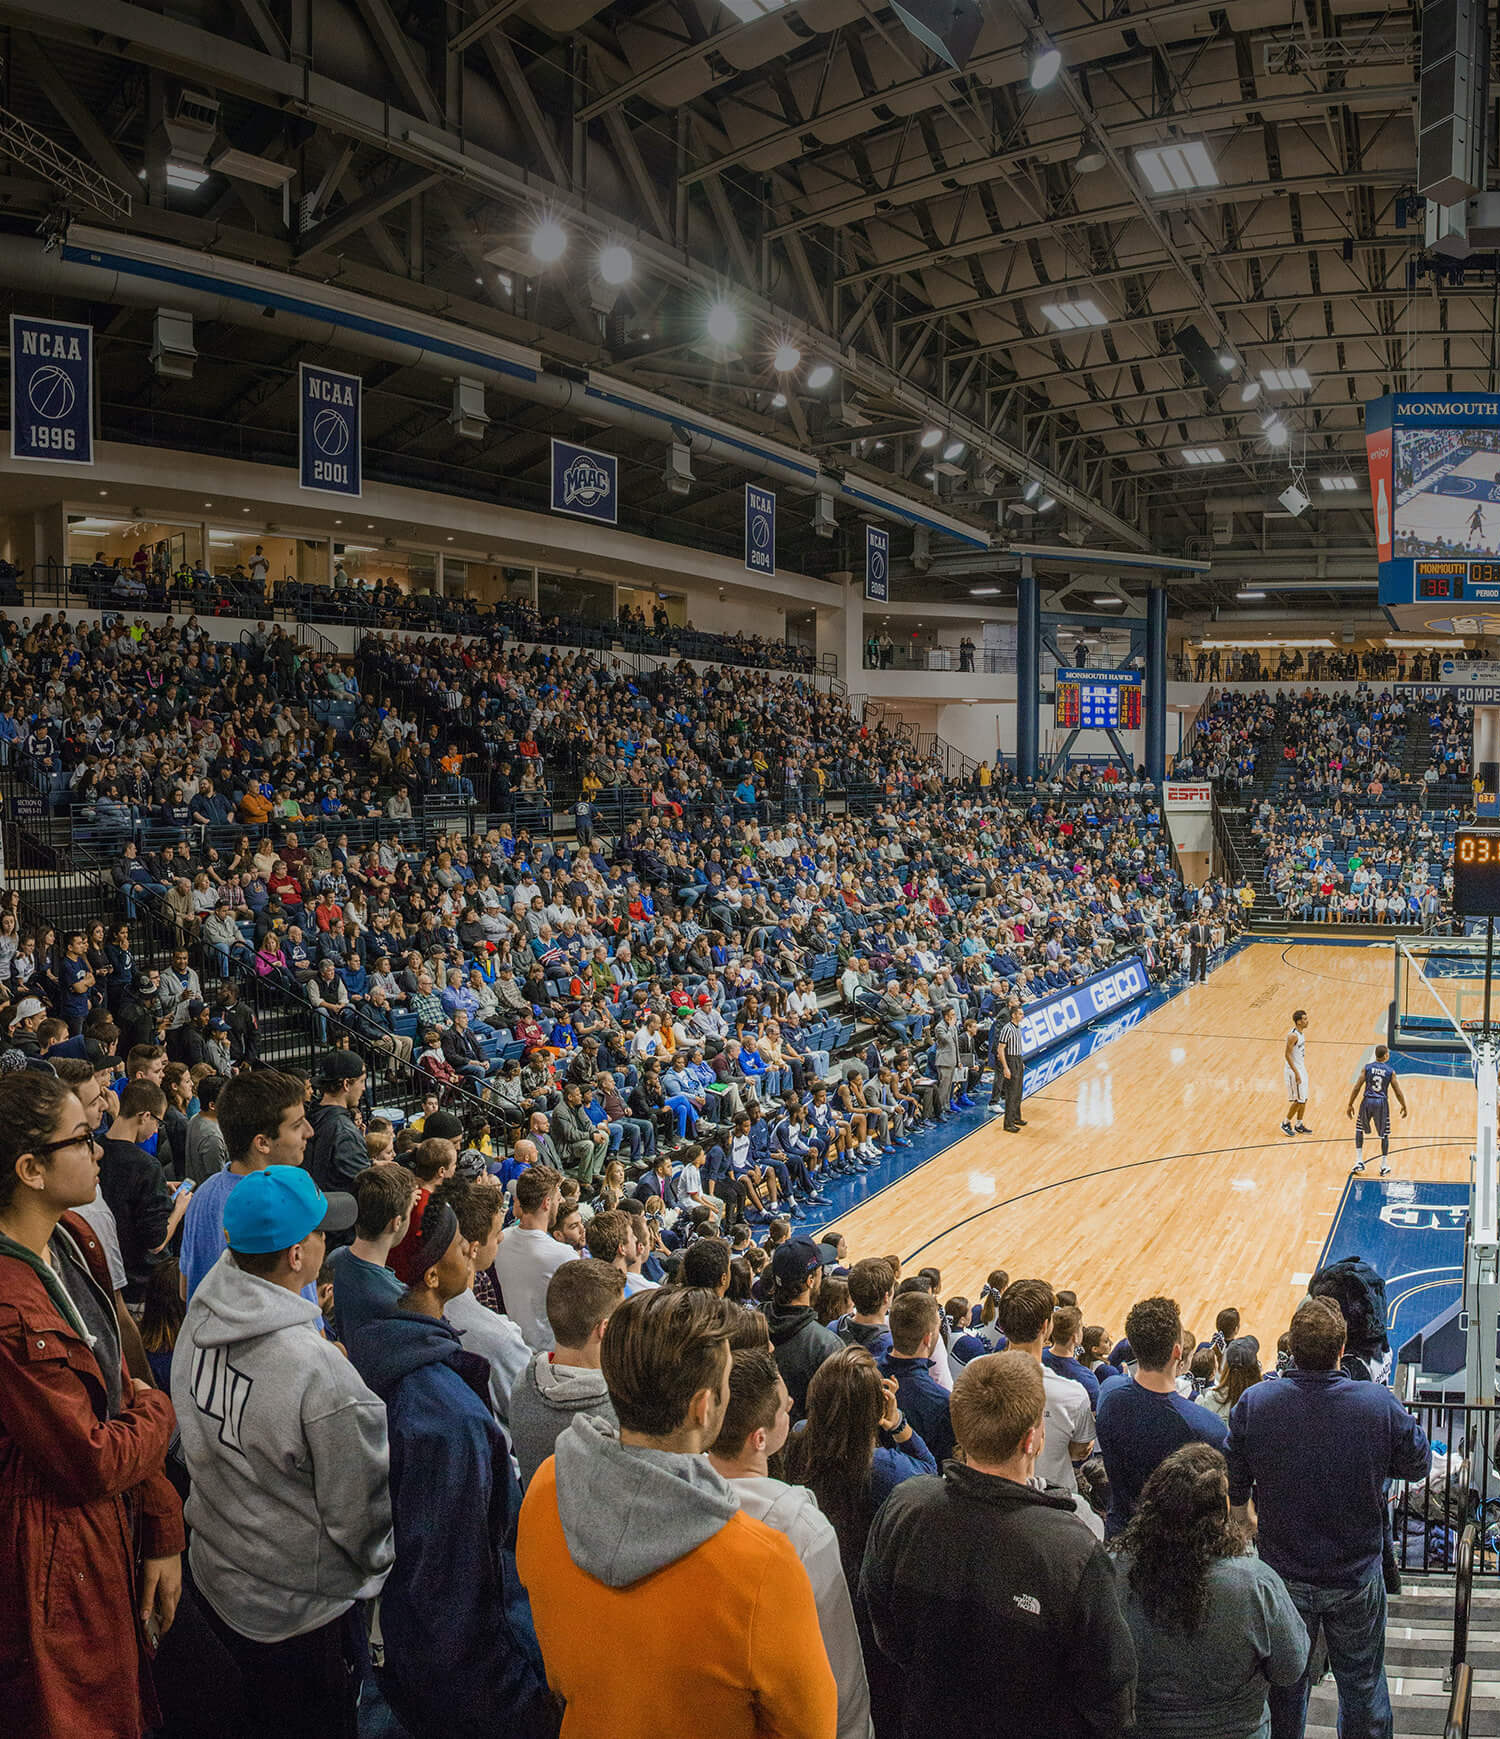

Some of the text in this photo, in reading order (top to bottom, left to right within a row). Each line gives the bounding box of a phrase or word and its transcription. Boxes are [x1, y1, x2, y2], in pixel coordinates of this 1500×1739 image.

[22, 330, 82, 360] NCAA
[308, 376, 354, 407] NCAA
[1397, 402, 1498, 417] MONMOUTH
[30, 425, 76, 450] 1996
[314, 460, 348, 484] 2001
[565, 466, 610, 501] MAAC
[750, 493, 772, 514] NCAA
[870, 533, 886, 550] NCAA
[751, 550, 770, 568] 2004
[1419, 563, 1465, 574] MONMOUTH
[1475, 589, 1499, 598] PERIOD
[1066, 672, 1107, 680] MONMOUTH
[1168, 787, 1210, 801] ESPN
[1479, 794, 1496, 803] 03.0
[1019, 966, 1141, 1052] GEICO GEICO
[1371, 1075, 1383, 1092] 3
